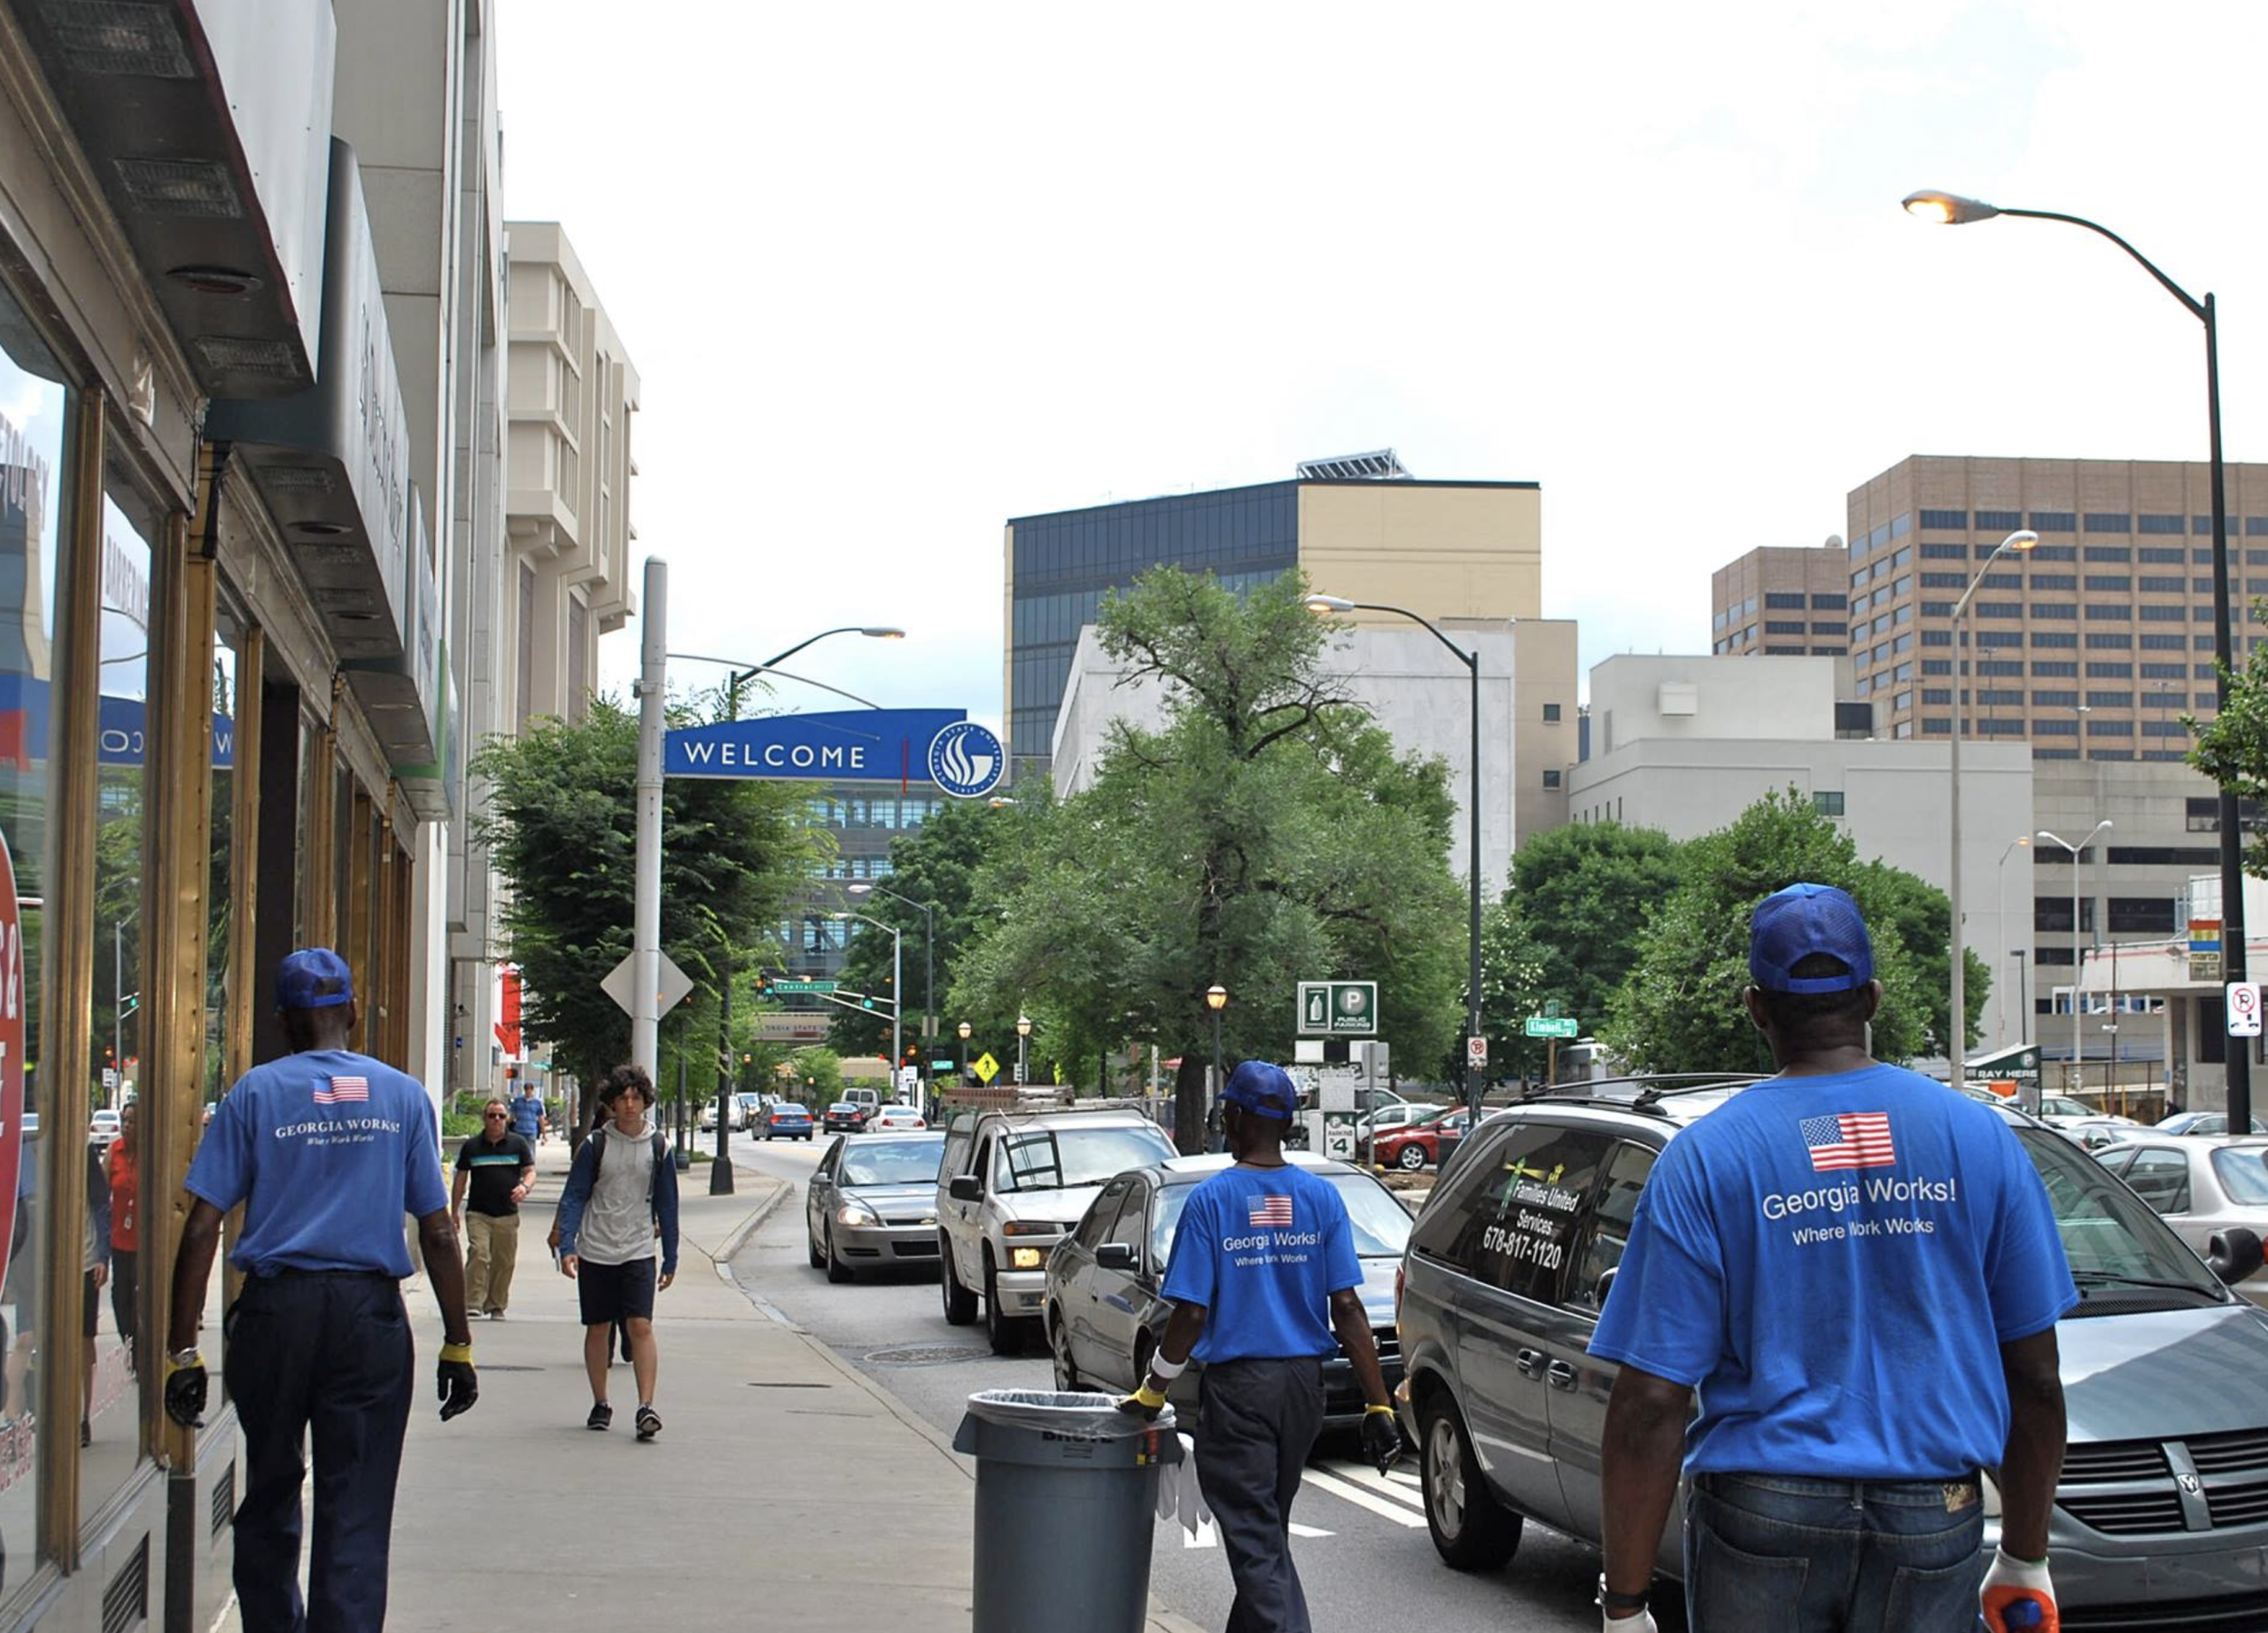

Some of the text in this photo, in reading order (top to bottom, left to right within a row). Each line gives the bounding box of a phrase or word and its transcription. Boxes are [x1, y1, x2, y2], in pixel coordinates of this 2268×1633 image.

[683, 742, 865, 769] WELCOME
[275, 1121, 344, 1139] GEORGIA
[1512, 1179, 1581, 1212] Families United
[1762, 1176, 1957, 1220] Georgia Works!
[1516, 1209, 1554, 1236] Services
[1791, 1225, 1845, 1246] Where
[1273, 1231, 1321, 1247] Works!
[1483, 1225, 1562, 1270] 678-817-1120
